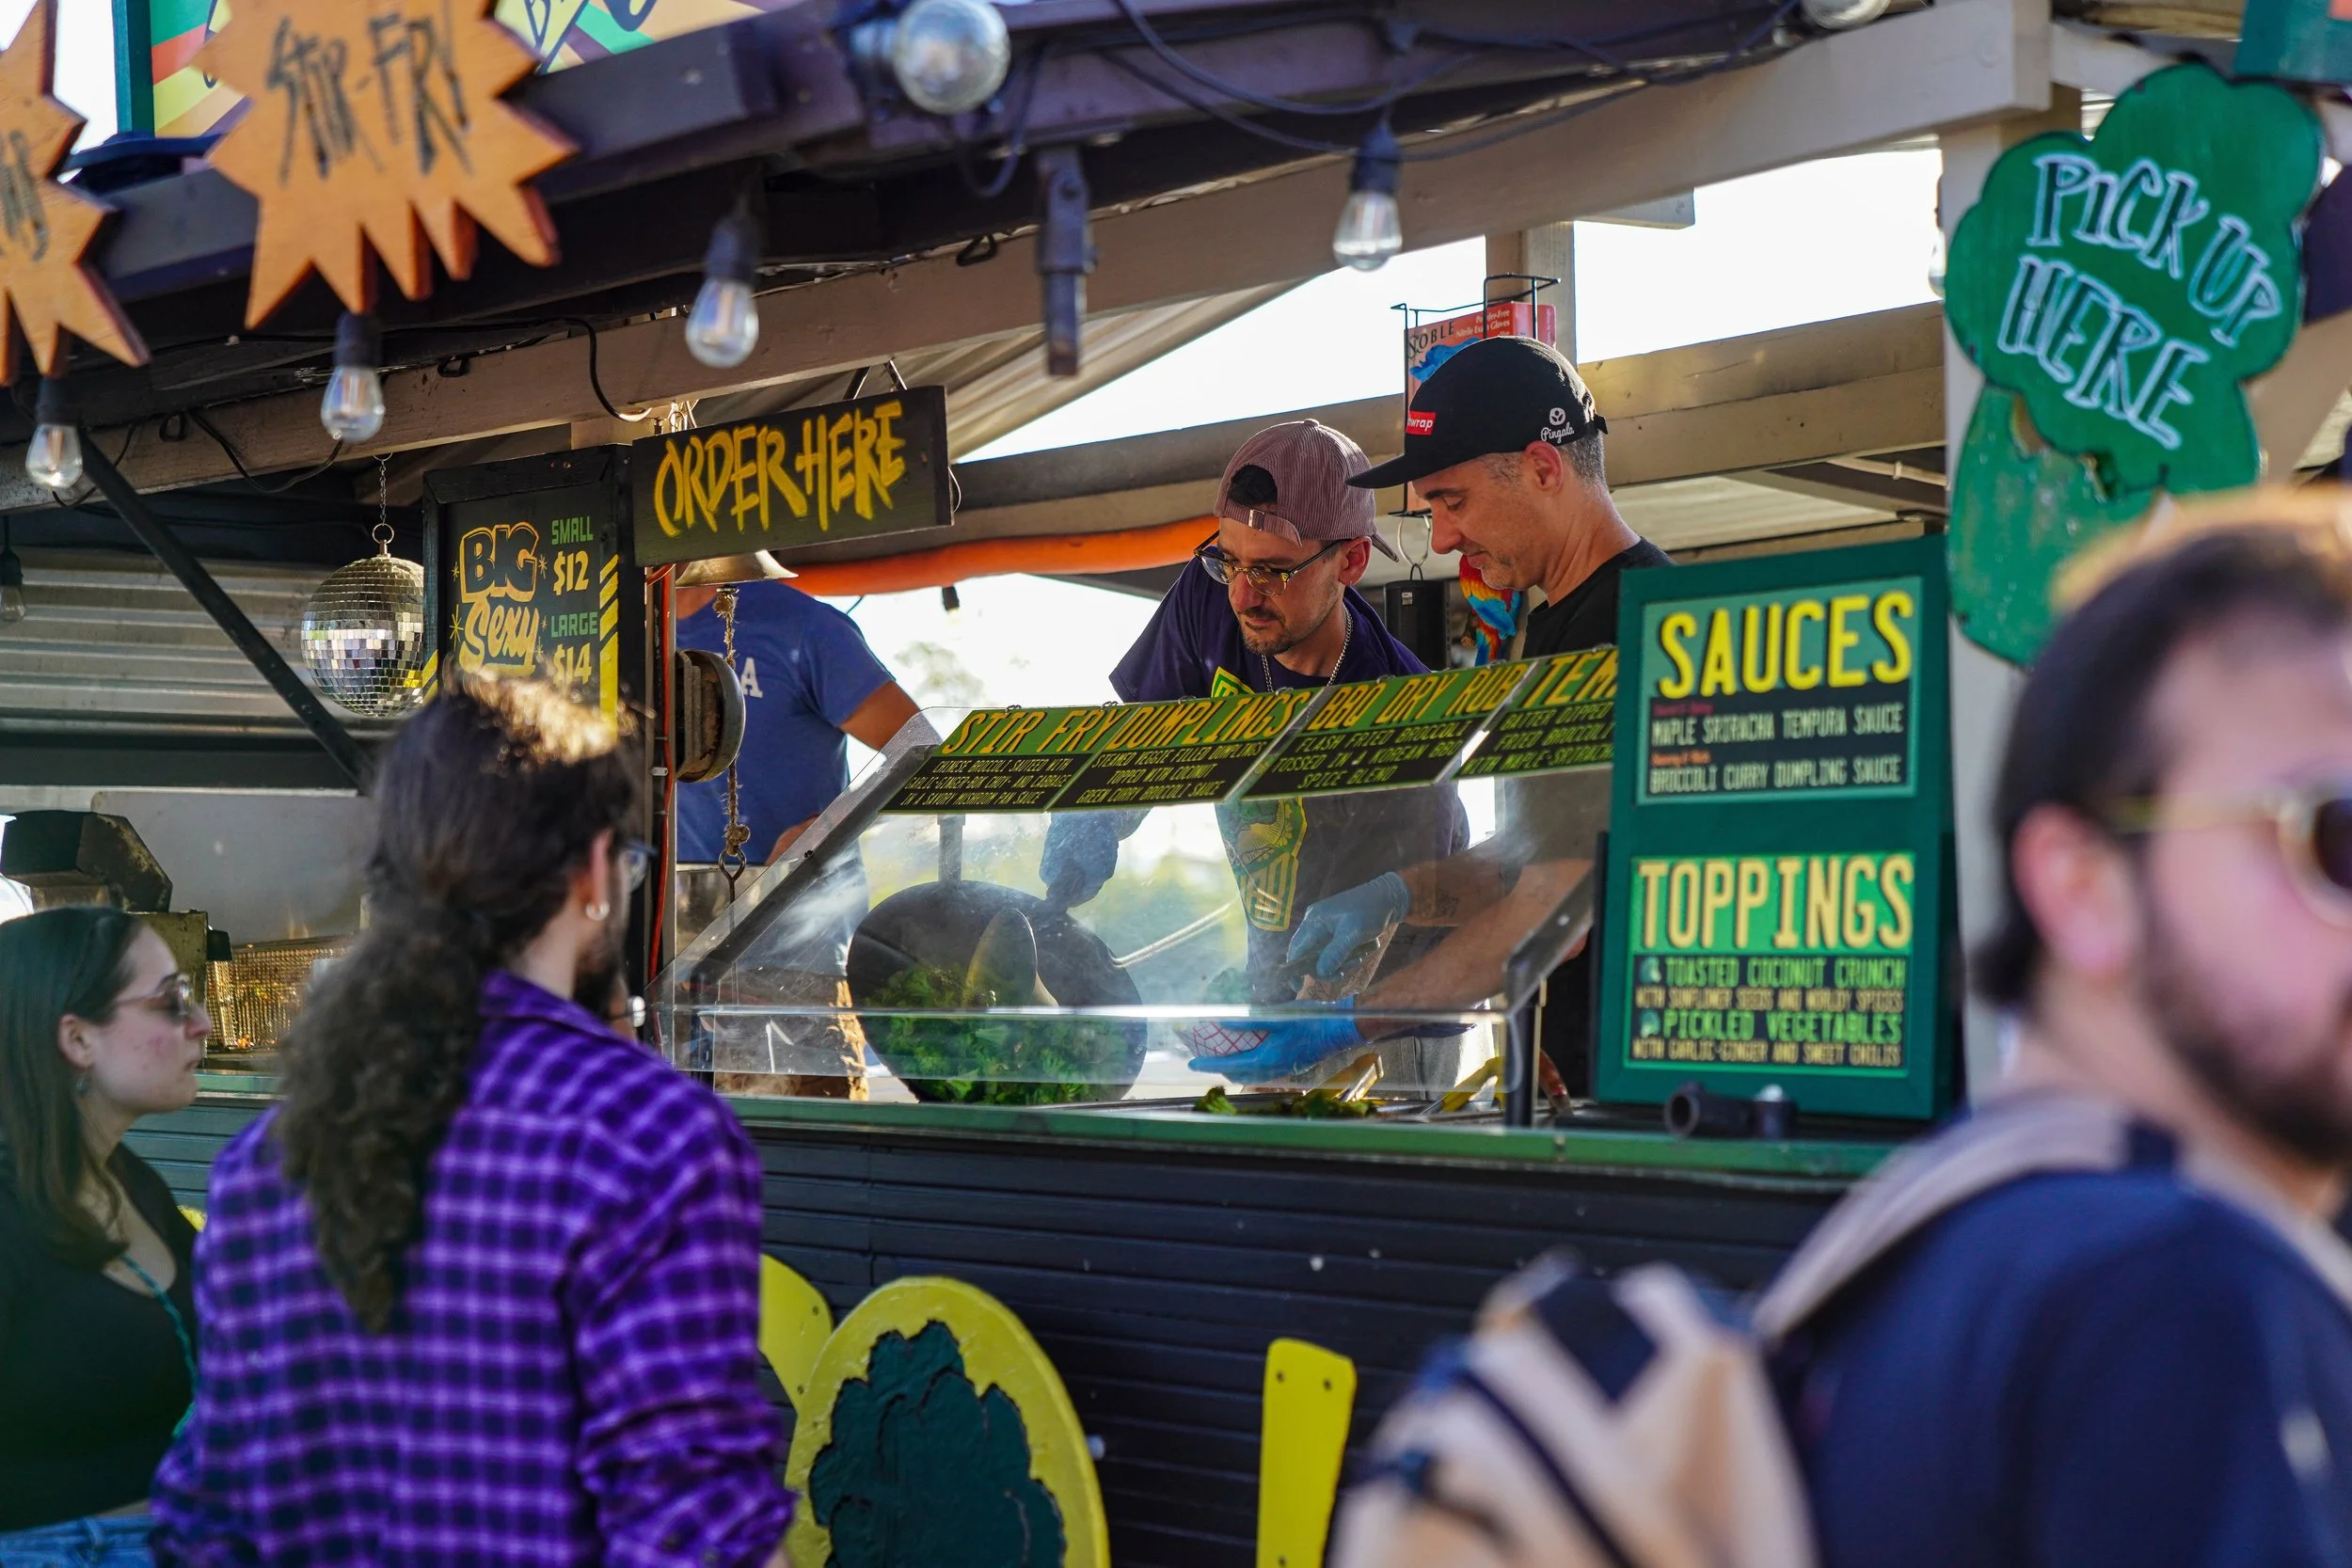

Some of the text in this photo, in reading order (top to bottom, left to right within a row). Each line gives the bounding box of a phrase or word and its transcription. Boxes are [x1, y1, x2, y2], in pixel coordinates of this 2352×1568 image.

[2027, 153, 2282, 348] PICK UP
[1997, 254, 2210, 450] HERE
[1540, 421, 1575, 443] Pingala
[654, 399, 906, 538] ORDER HERE
[551, 516, 594, 545] SMALL
[459, 521, 540, 603] BIG
[553, 550, 589, 595] $12
[458, 597, 540, 677] Sexy
[550, 611, 598, 638] LARGE
[1657, 590, 1914, 699] SAUCES
[553, 642, 593, 687] $14
[1307, 663, 1528, 731] BBQ DRY RUB
[942, 708, 1130, 754] STIR FRY
[1104, 691, 1311, 751] DUMPLINGS
[1500, 701, 1615, 731] BATTER DIPPED
[1652, 702, 1904, 747] MAPLE SRIRACHA TEMPURA SAUCE
[1297, 720, 1473, 753] FLASH FRIED BROCCOLI
[1494, 722, 1616, 752] FRIED BROCCOLI
[932, 758, 1074, 773] CHINESE BROCCOLI SAUTEED WITH
[1091, 741, 1268, 768] STEAMED VEGGIE FILLED DUMPLINGS
[1272, 738, 1464, 773] TOSSED IN A KOREAN BBQ
[1459, 755, 1502, 775] WITH
[1011, 776, 1035, 788] AND
[1033, 774, 1073, 788] CABBAGE
[1106, 764, 1217, 784] TOPPED WITH COCONUT
[1296, 766, 1397, 789] SPICE BLEND
[1650, 755, 1902, 793] BROCCOLI CURRY DUMPLING SAUCE
[900, 791, 1046, 806] IN A SAVORY MUSHROOM PAN SAUCE
[1076, 781, 1225, 803] GREEN CURRY BROCCOLI SAUCE
[1639, 854, 1914, 950] TOPPINGS
[1665, 957, 1906, 989] TOASTED COCONUT CRUNCH
[1777, 988, 1802, 1011] AND
[1663, 1009, 1902, 1044] PICKLED VEGETABLES
[1772, 1041, 1799, 1064] AND
